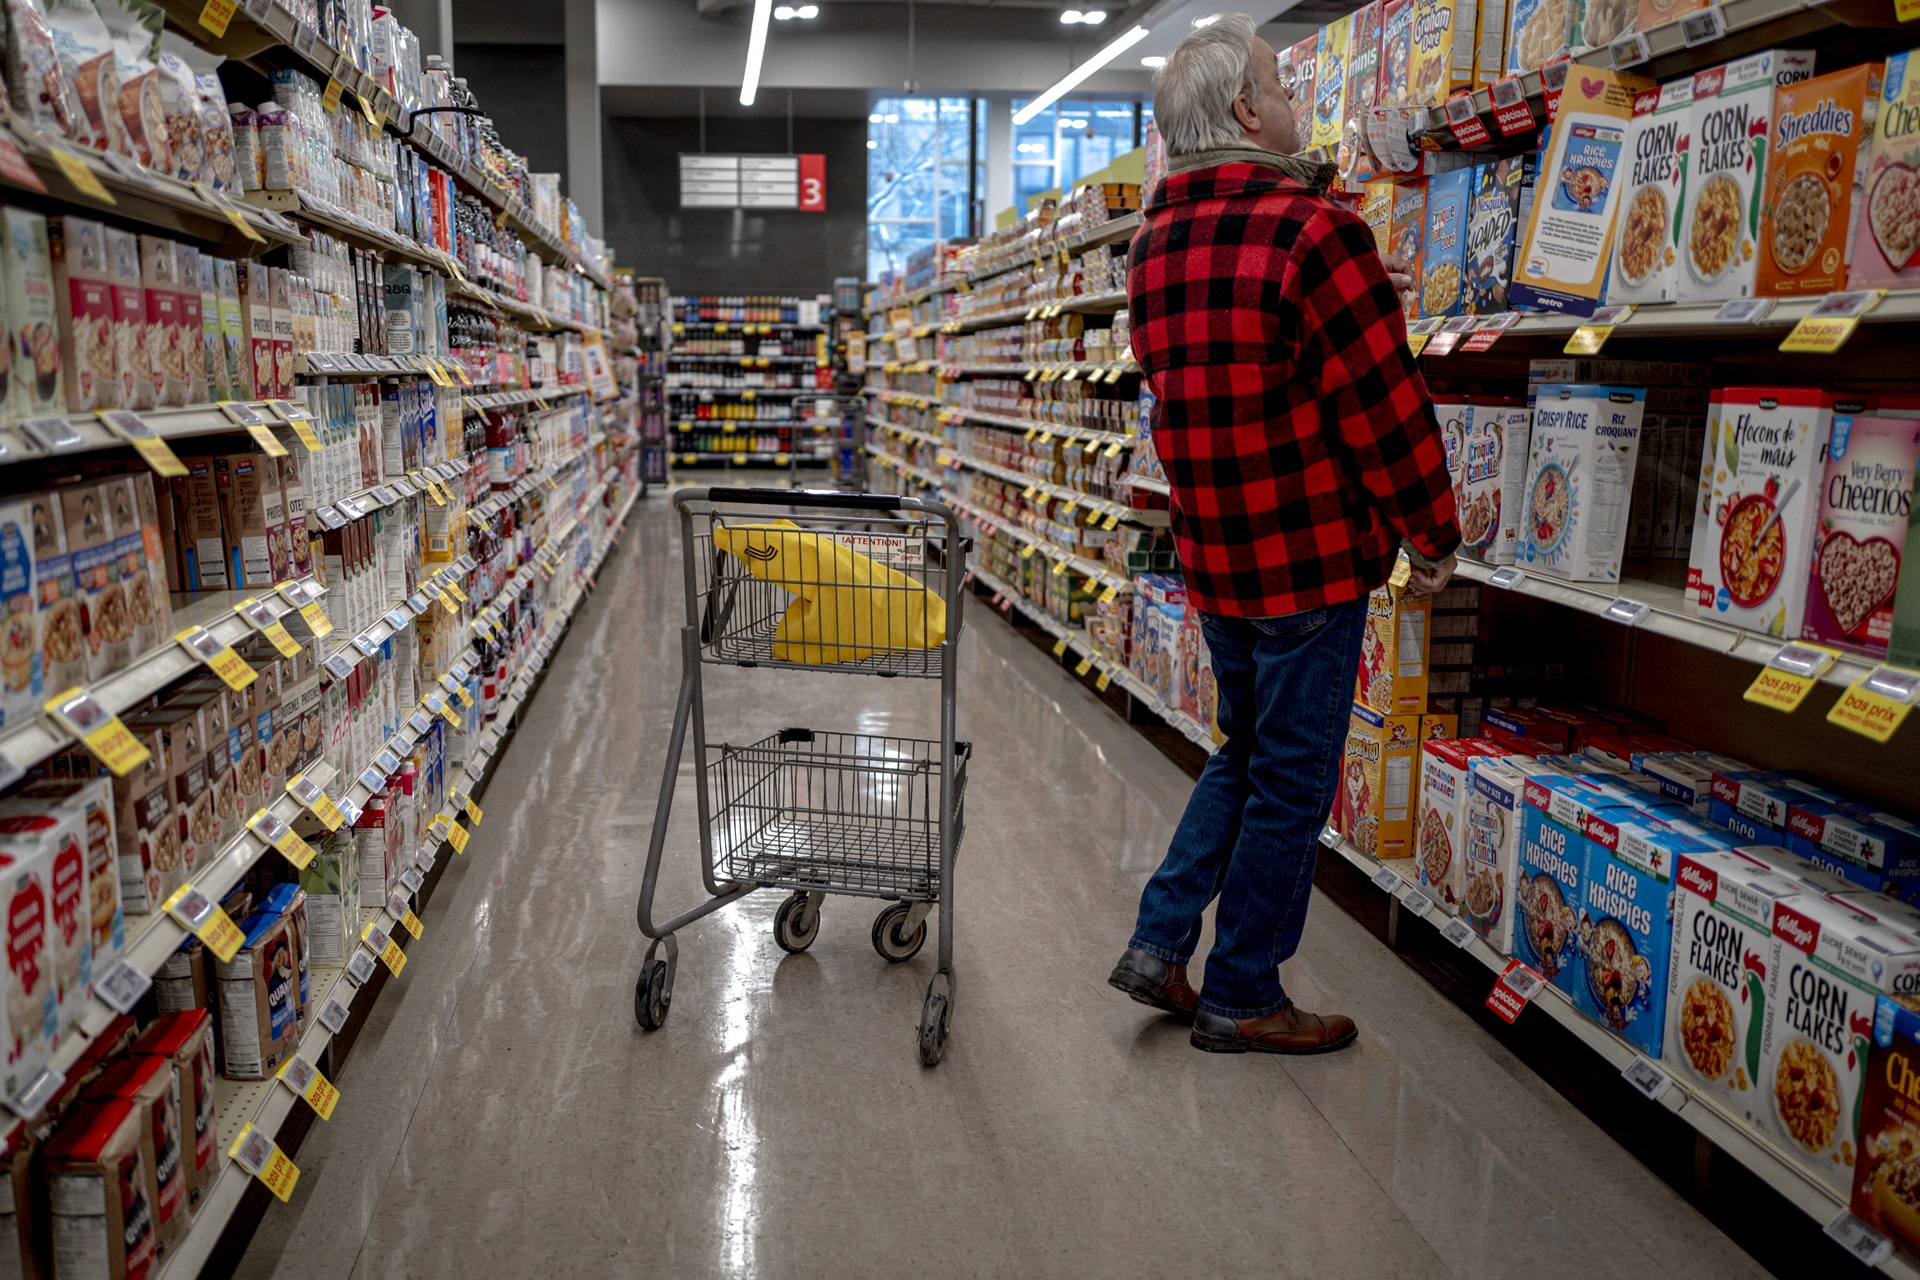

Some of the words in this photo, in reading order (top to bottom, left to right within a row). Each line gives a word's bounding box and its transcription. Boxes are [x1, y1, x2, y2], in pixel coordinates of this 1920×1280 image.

[1414, 7, 1451, 44] Graham
[1350, 48, 1377, 78] minis
[1776, 71, 1809, 86] CORN
[1498, 108, 1529, 124] spéciaux
[1701, 103, 1748, 146] CORN
[1776, 100, 1852, 150] Shreddies
[1884, 101, 1920, 139] Che
[1454, 122, 1482, 138] spéciaux
[1636, 121, 1678, 160] CORN
[1584, 145, 1606, 156] Rice
[1699, 140, 1745, 175] FLAKES
[1632, 154, 1672, 186] FLAKES
[803, 178, 822, 205] 3
[1469, 210, 1512, 263] LOADED
[1537, 297, 1563, 308] metro
[1537, 409, 1566, 428] CRISPY
[1565, 410, 1588, 430] RICE
[1596, 426, 1638, 438] CROQUANT
[1612, 414, 1626, 425] RIZ
[1734, 413, 1781, 447] Flocons
[1782, 418, 1796, 444] de
[1470, 441, 1495, 462] Croque
[1468, 458, 1499, 482] Cannelle
[1852, 462, 1874, 484] Very
[1874, 464, 1905, 488] Berry
[1829, 474, 1912, 517] Cheerios
[1760, 674, 1780, 688] bas
[1778, 682, 1804, 695] prix
[1844, 694, 1869, 711] bas
[1866, 704, 1897, 722] prix
[1476, 779, 1491, 793] FAMILY
[1491, 787, 1502, 800] SIZE
[1526, 786, 1549, 806] Kellogg's
[1666, 784, 1679, 795] SIZE
[1713, 780, 1736, 800] Kellogg's
[1747, 791, 1760, 802] SOURCE
[1747, 796, 1765, 808] VITAMINES
[1588, 821, 1617, 845] Kellogg's
[1791, 815, 1821, 836] Kellogg's
[1835, 827, 1851, 838] SOURCE
[1540, 823, 1566, 856] Rice
[1627, 835, 1642, 846] SOURCE
[1628, 840, 1647, 856] VITAMINES
[1834, 833, 1857, 848] VITAMINES
[1606, 862, 1637, 900] Rice
[1681, 866, 1714, 892] Kellogg's
[1694, 910, 1743, 964] CORN
[1777, 914, 1813, 945] Kellogg's
[1670, 948, 1680, 996] FORMAT
[1675, 892, 1686, 944] FAMILIAL
[1690, 940, 1738, 990] FLAKES
[1790, 964, 1848, 1026] CORN
[1893, 974, 1920, 991] COR
[1493, 987, 1522, 1012] spéciaux
[1762, 1003, 1775, 1055] FORMAT
[1769, 942, 1782, 1000] FAMILIAL
[1498, 1004, 1515, 1020] semaine
[1787, 996, 1844, 1054] FLAKES
[310, 1093, 320, 1106] bas
[317, 1078, 328, 1097] prix
[266, 1168, 280, 1187] bas
[274, 1155, 286, 1175] prix
